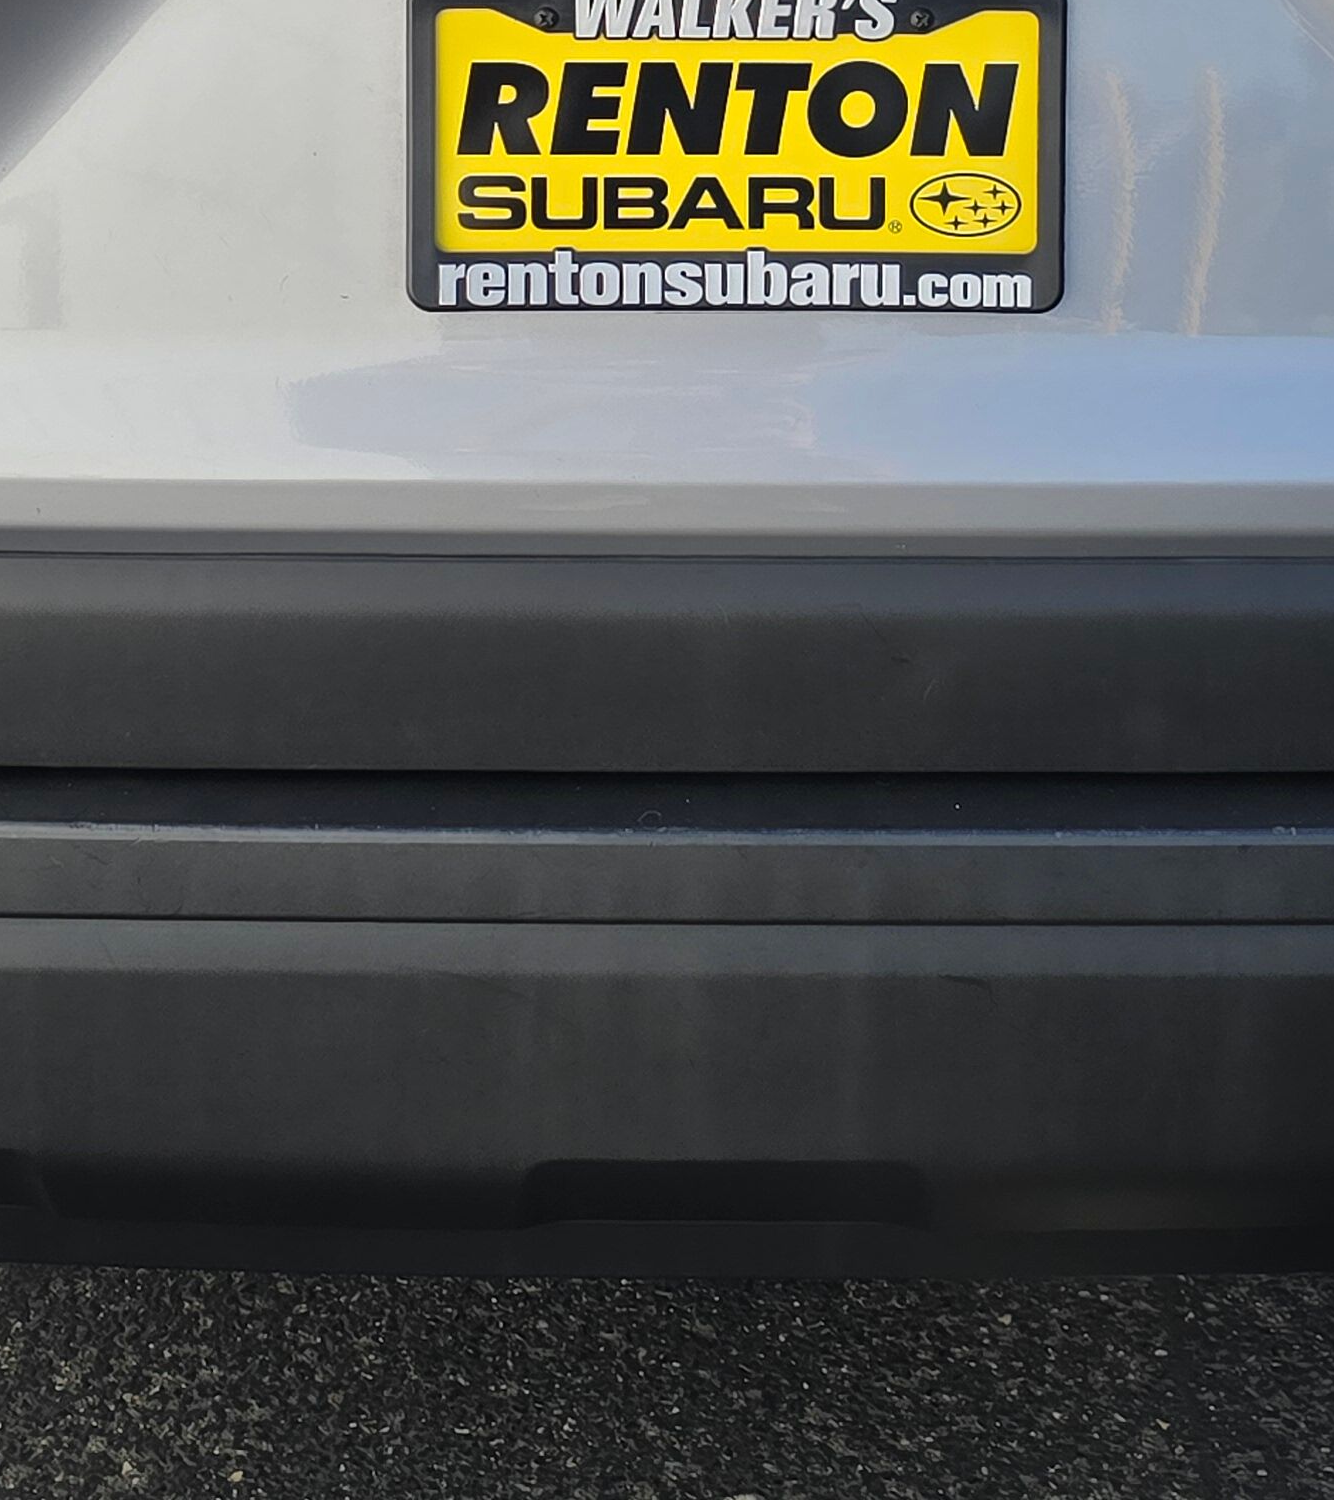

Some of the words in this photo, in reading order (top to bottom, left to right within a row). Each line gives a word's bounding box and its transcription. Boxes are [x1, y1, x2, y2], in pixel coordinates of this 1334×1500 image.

[456, 60, 1020, 158] RENTON
[457, 175, 886, 231] SUBARU
[437, 249, 1033, 308] rentonsubaru.com
